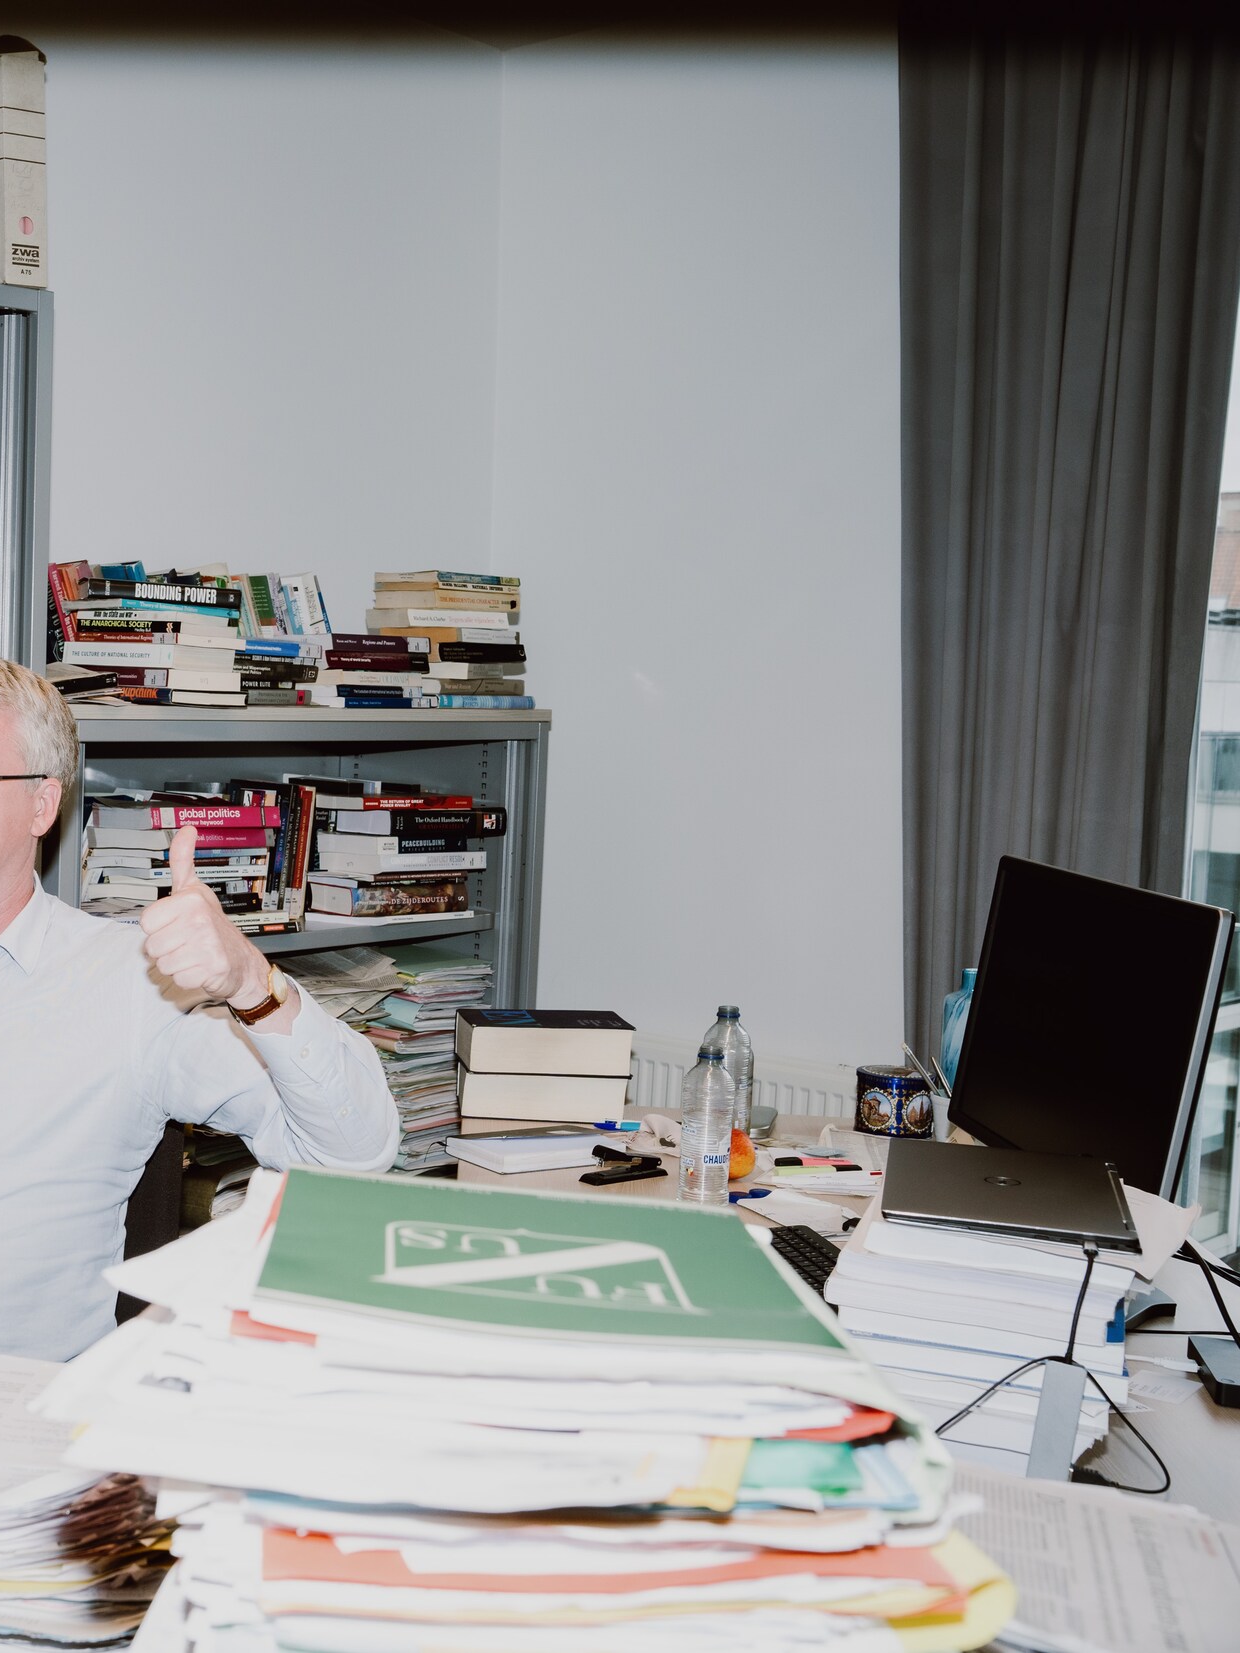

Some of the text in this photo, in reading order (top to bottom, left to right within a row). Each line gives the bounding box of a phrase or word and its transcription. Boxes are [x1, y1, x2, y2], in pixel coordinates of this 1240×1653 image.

[12, 248, 39, 258] zwa
[134, 583, 217, 604] BOUNDING POWER
[92, 620, 127, 628] ANARCHICAL
[178, 807, 241, 820] global politics
[206, 834, 224, 842] politics
[401, 839, 445, 847] PEACEBUILDING
[402, 896, 448, 905] ZIJDEROUTES
